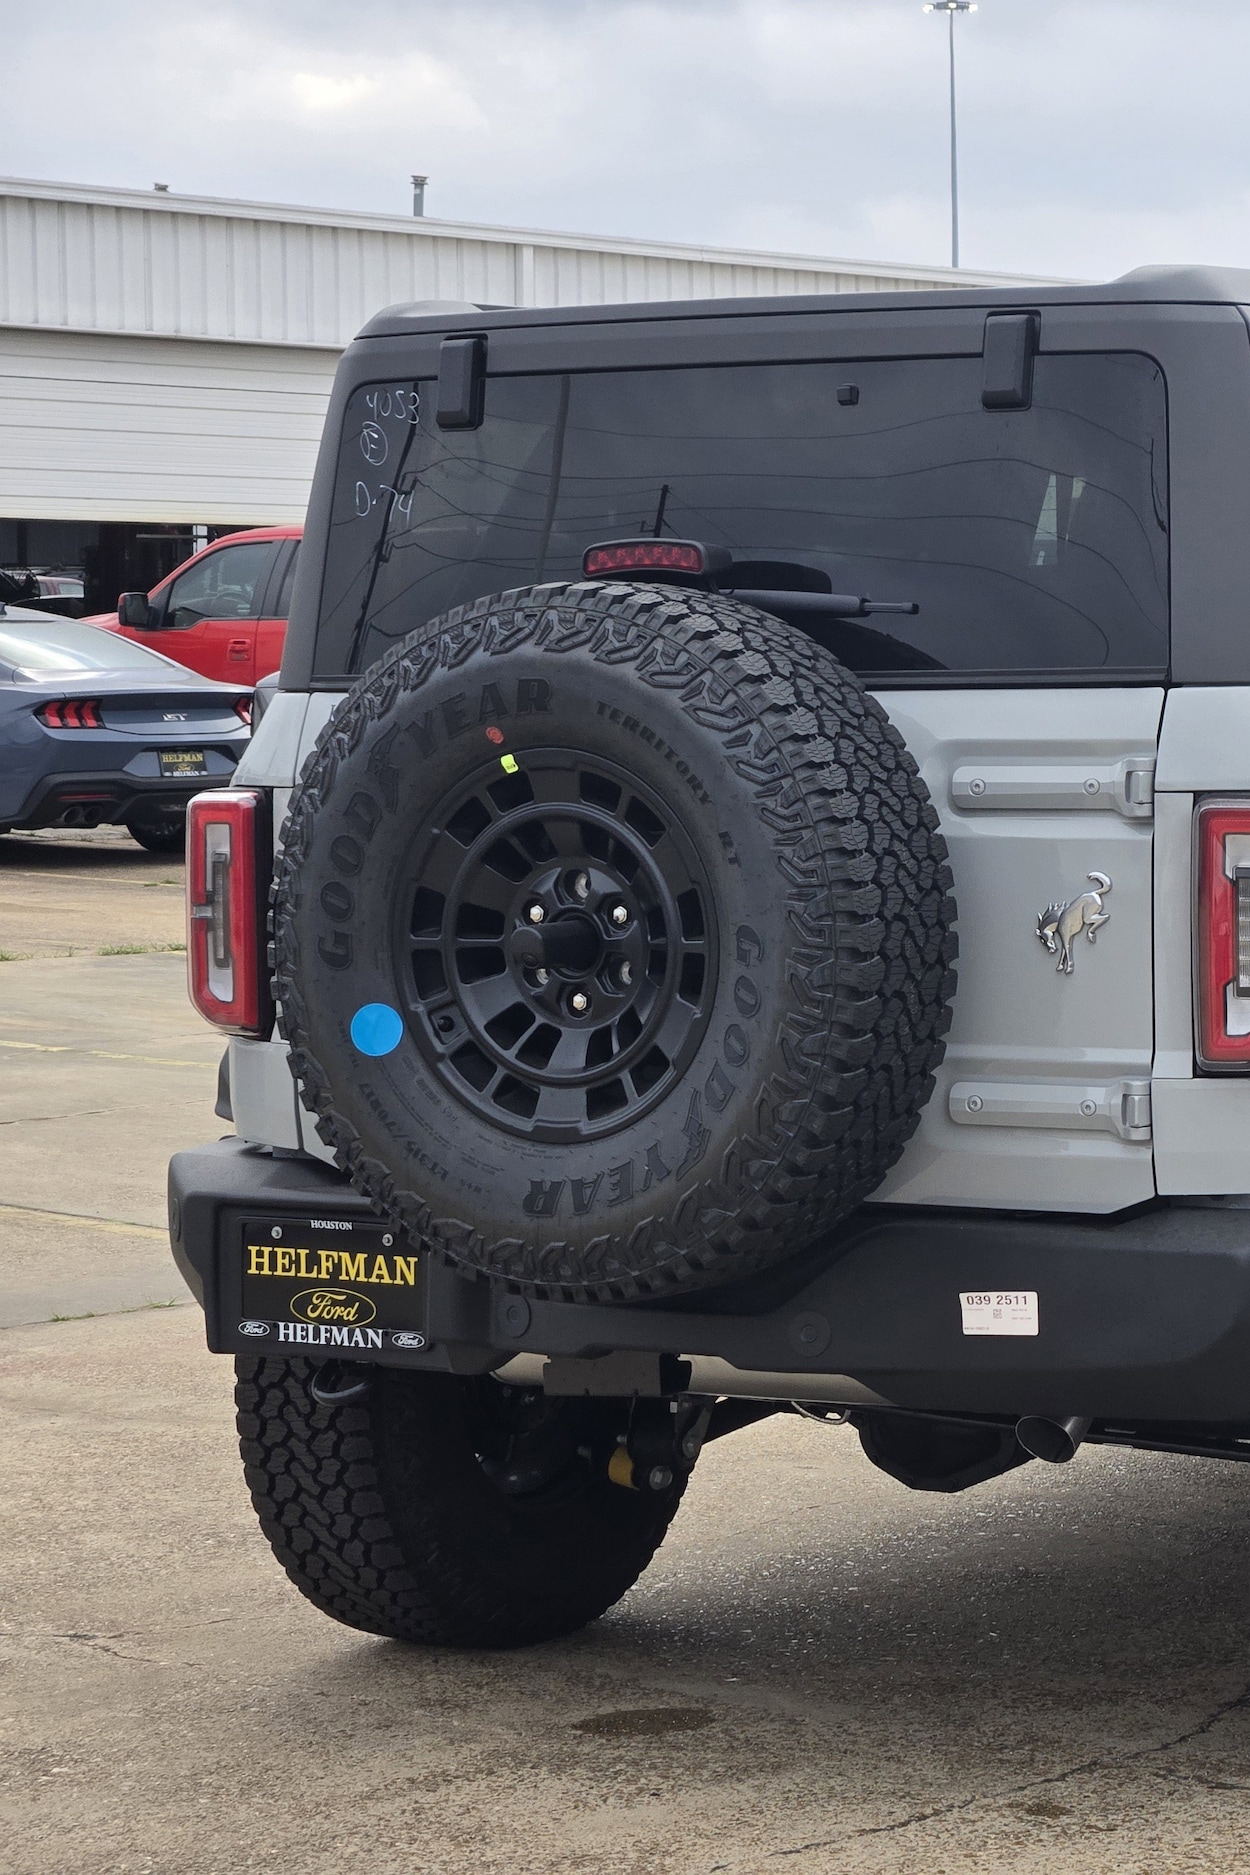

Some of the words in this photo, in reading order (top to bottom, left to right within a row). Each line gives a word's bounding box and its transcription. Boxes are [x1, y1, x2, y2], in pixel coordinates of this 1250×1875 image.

[366, 390, 420, 424] 4053
[162, 753, 203, 763] HELFMAN
[596, 700, 715, 805] TERRITORY
[317, 677, 552, 970] GOODYEAR
[522, 924, 764, 1217] GOODYEAR
[310, 1219, 353, 1231] HOUSTON
[247, 1244, 419, 1286] HELFMAN
[306, 1291, 359, 1322] Ford
[966, 1295, 991, 1305] 039
[996, 1295, 1028, 1305] 2511
[277, 1321, 384, 1349] HELFMAN
